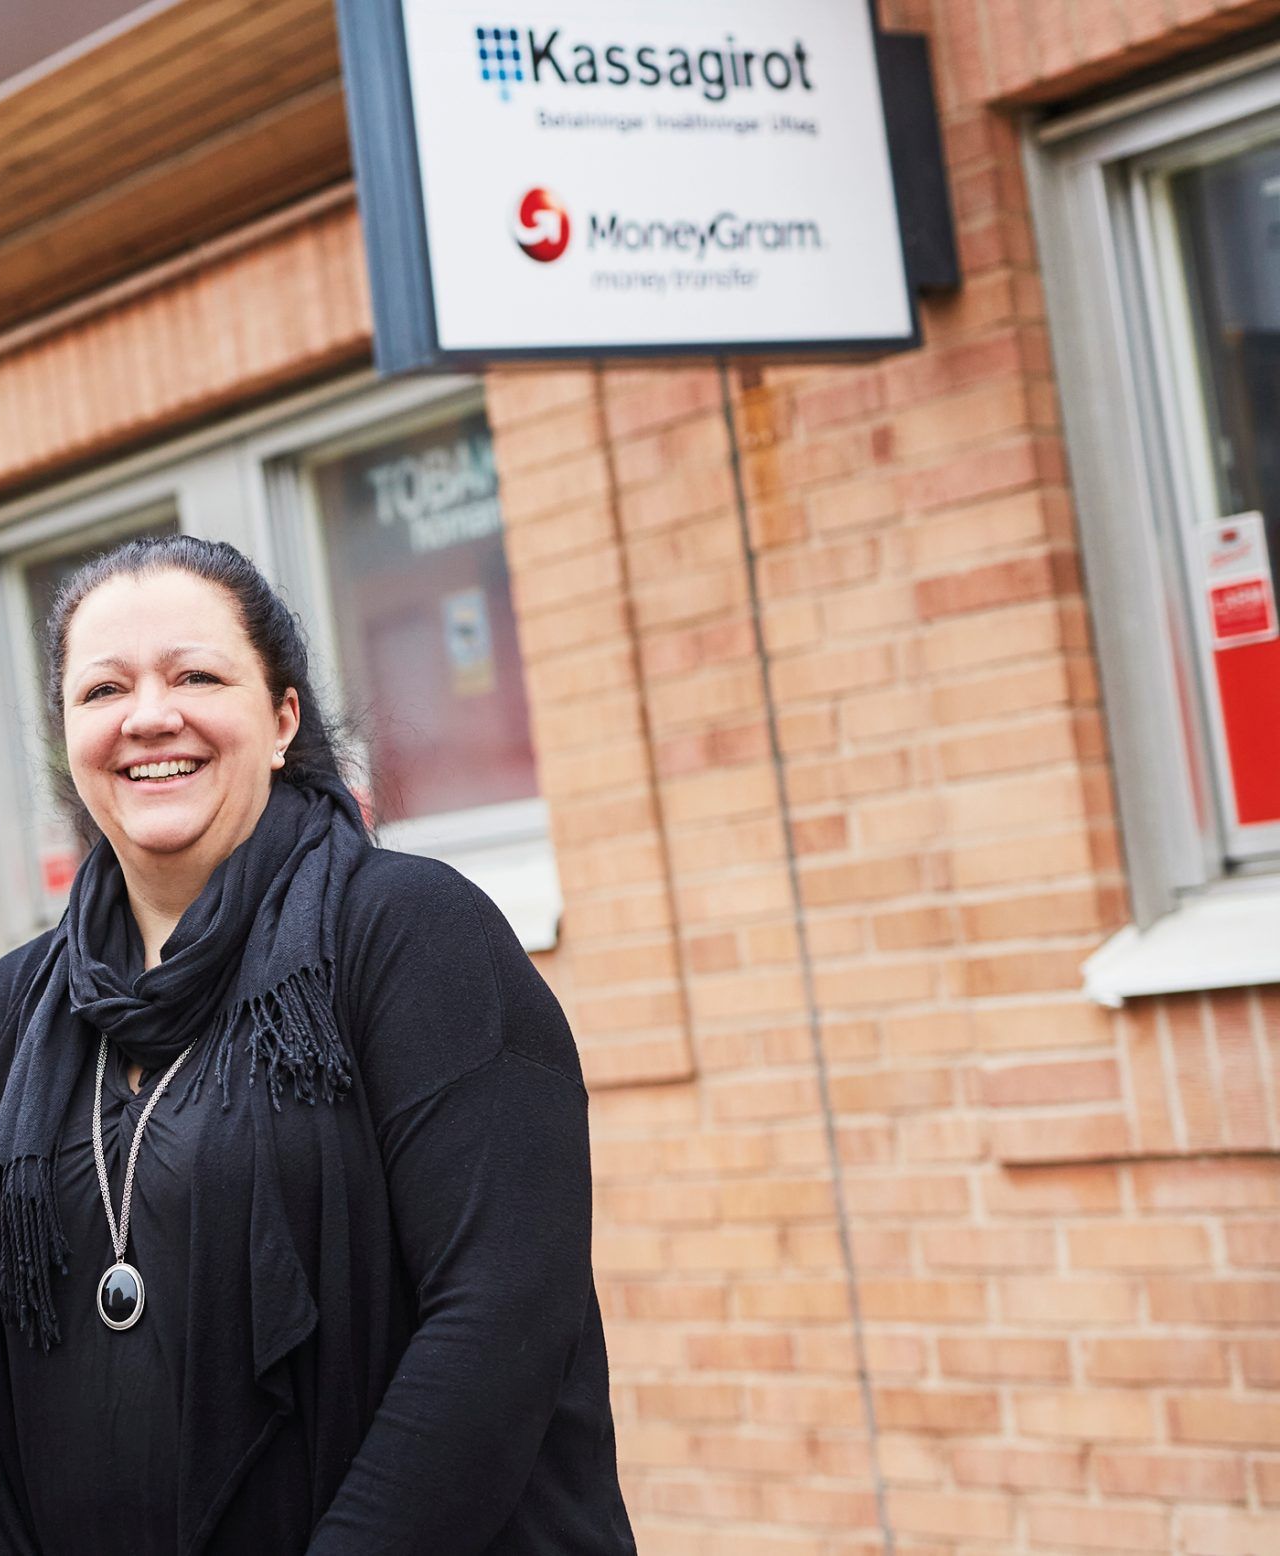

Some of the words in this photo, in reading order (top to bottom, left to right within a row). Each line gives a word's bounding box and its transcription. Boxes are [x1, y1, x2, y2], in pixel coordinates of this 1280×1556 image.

[526, 28, 814, 102] Kassagirot
[587, 211, 822, 261] MoneyGram
[591, 270, 667, 296] money
[673, 264, 758, 289] transfer
